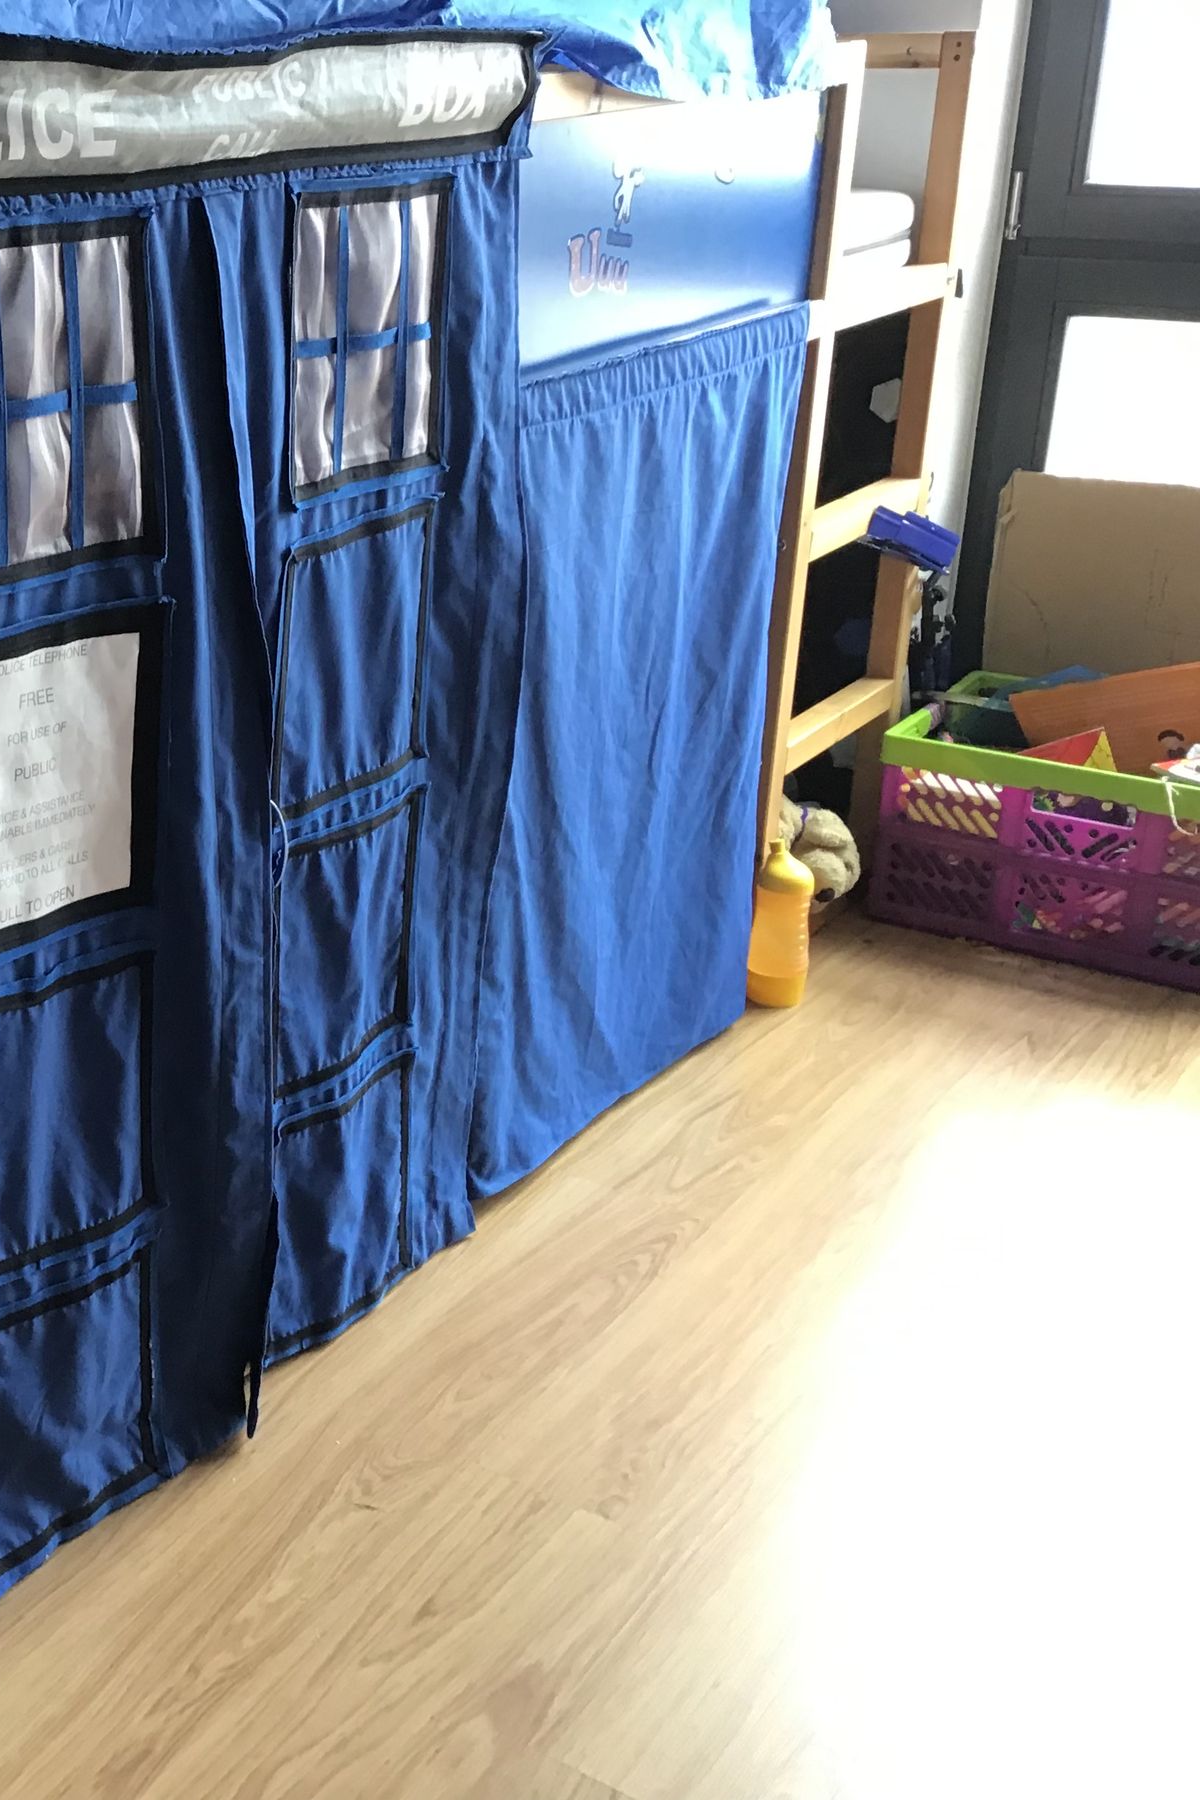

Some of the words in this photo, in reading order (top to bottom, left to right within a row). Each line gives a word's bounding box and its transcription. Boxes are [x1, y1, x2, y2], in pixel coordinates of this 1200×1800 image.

[192, 60, 307, 104] PUBLIC
[29, 644, 88, 668] TELEPHONE
[18, 687, 55, 710] FREE
[7, 731, 28, 747] FOR
[31, 727, 51, 741] USE
[52, 721, 67, 734] OF
[14, 757, 57, 781] PUBLIC
[21, 808, 27, 819] &
[29, 790, 85, 816] ASSISTANCE
[35, 803, 96, 830] IMMEDIATELY
[39, 848, 45, 859] &
[27, 867, 38, 878] TO
[41, 862, 55, 875] ALL
[25, 898, 42, 914] TO
[44, 884, 75, 906] OPEN
